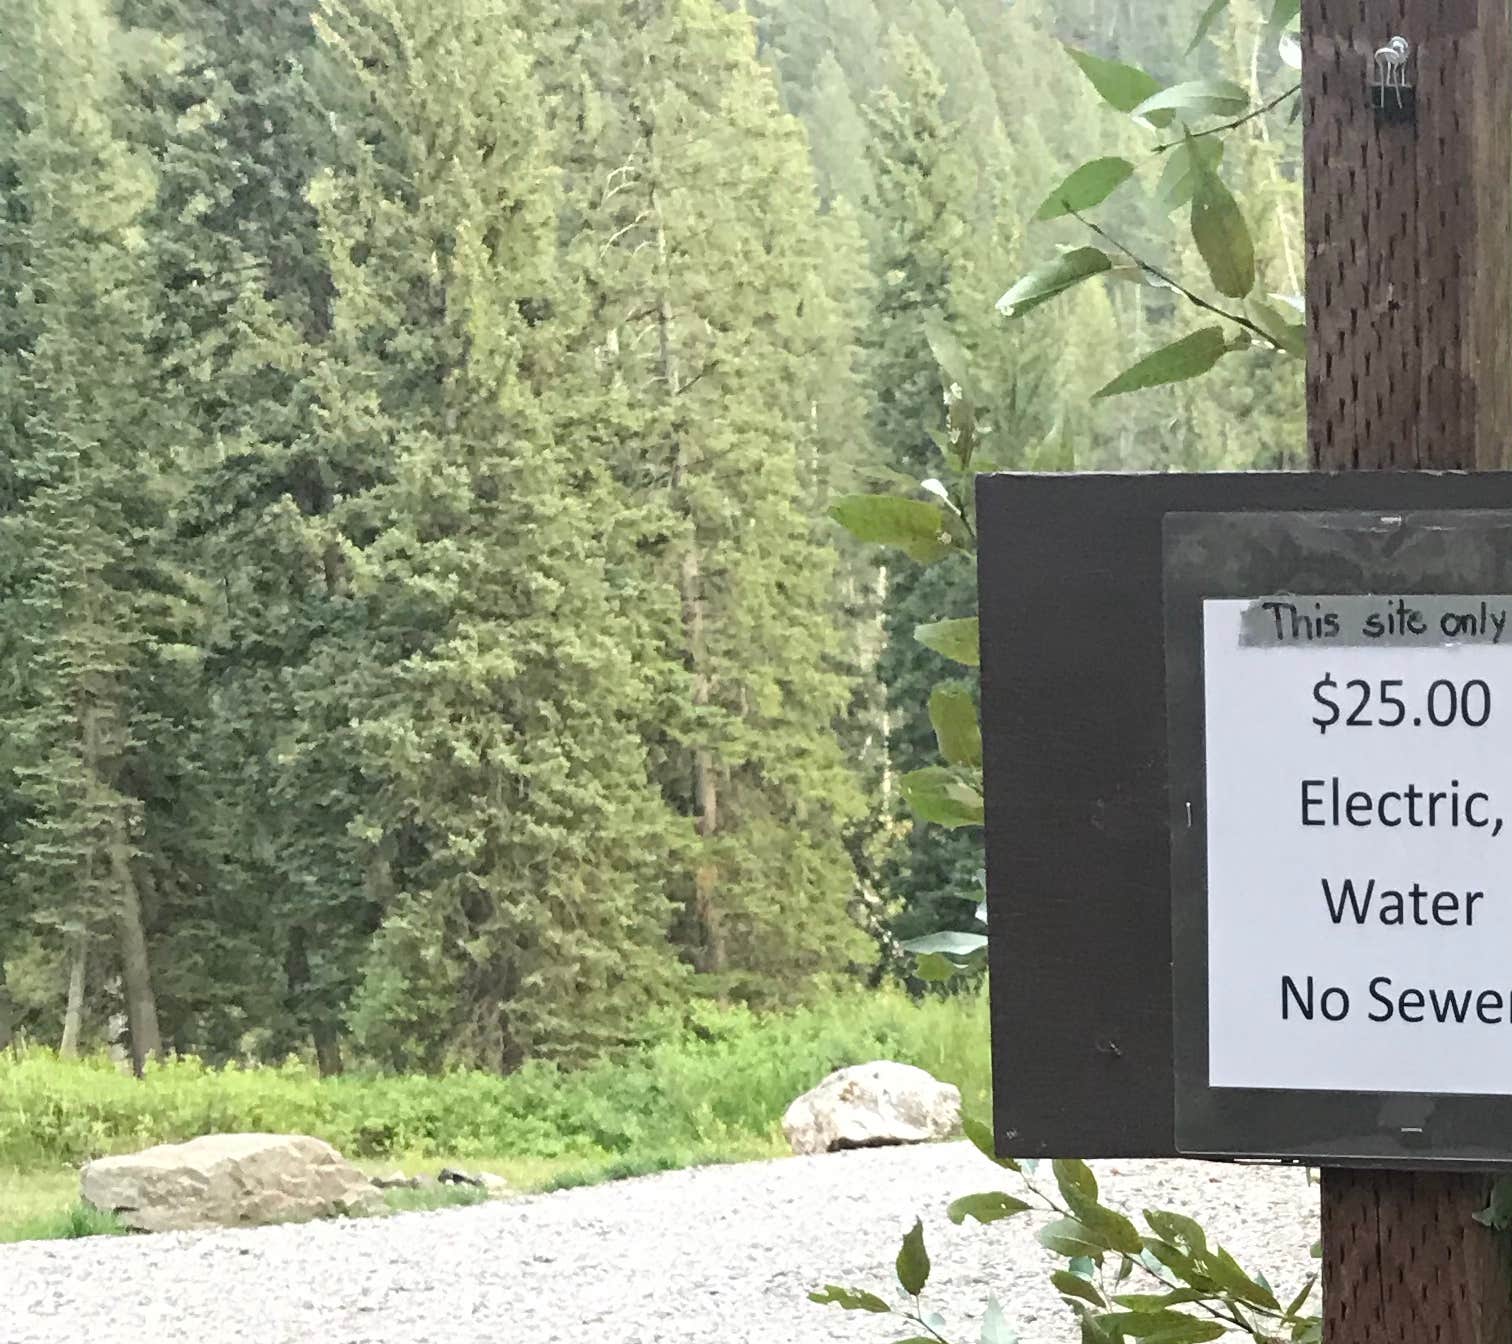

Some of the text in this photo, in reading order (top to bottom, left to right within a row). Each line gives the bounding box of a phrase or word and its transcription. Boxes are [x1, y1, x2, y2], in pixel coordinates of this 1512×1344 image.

[1262, 598, 1507, 644] This site only
[1311, 672, 1492, 735] $25.00
[1300, 777, 1504, 837] Electric,
[1321, 878, 1485, 926] Water
[1280, 975, 1350, 1022] No
